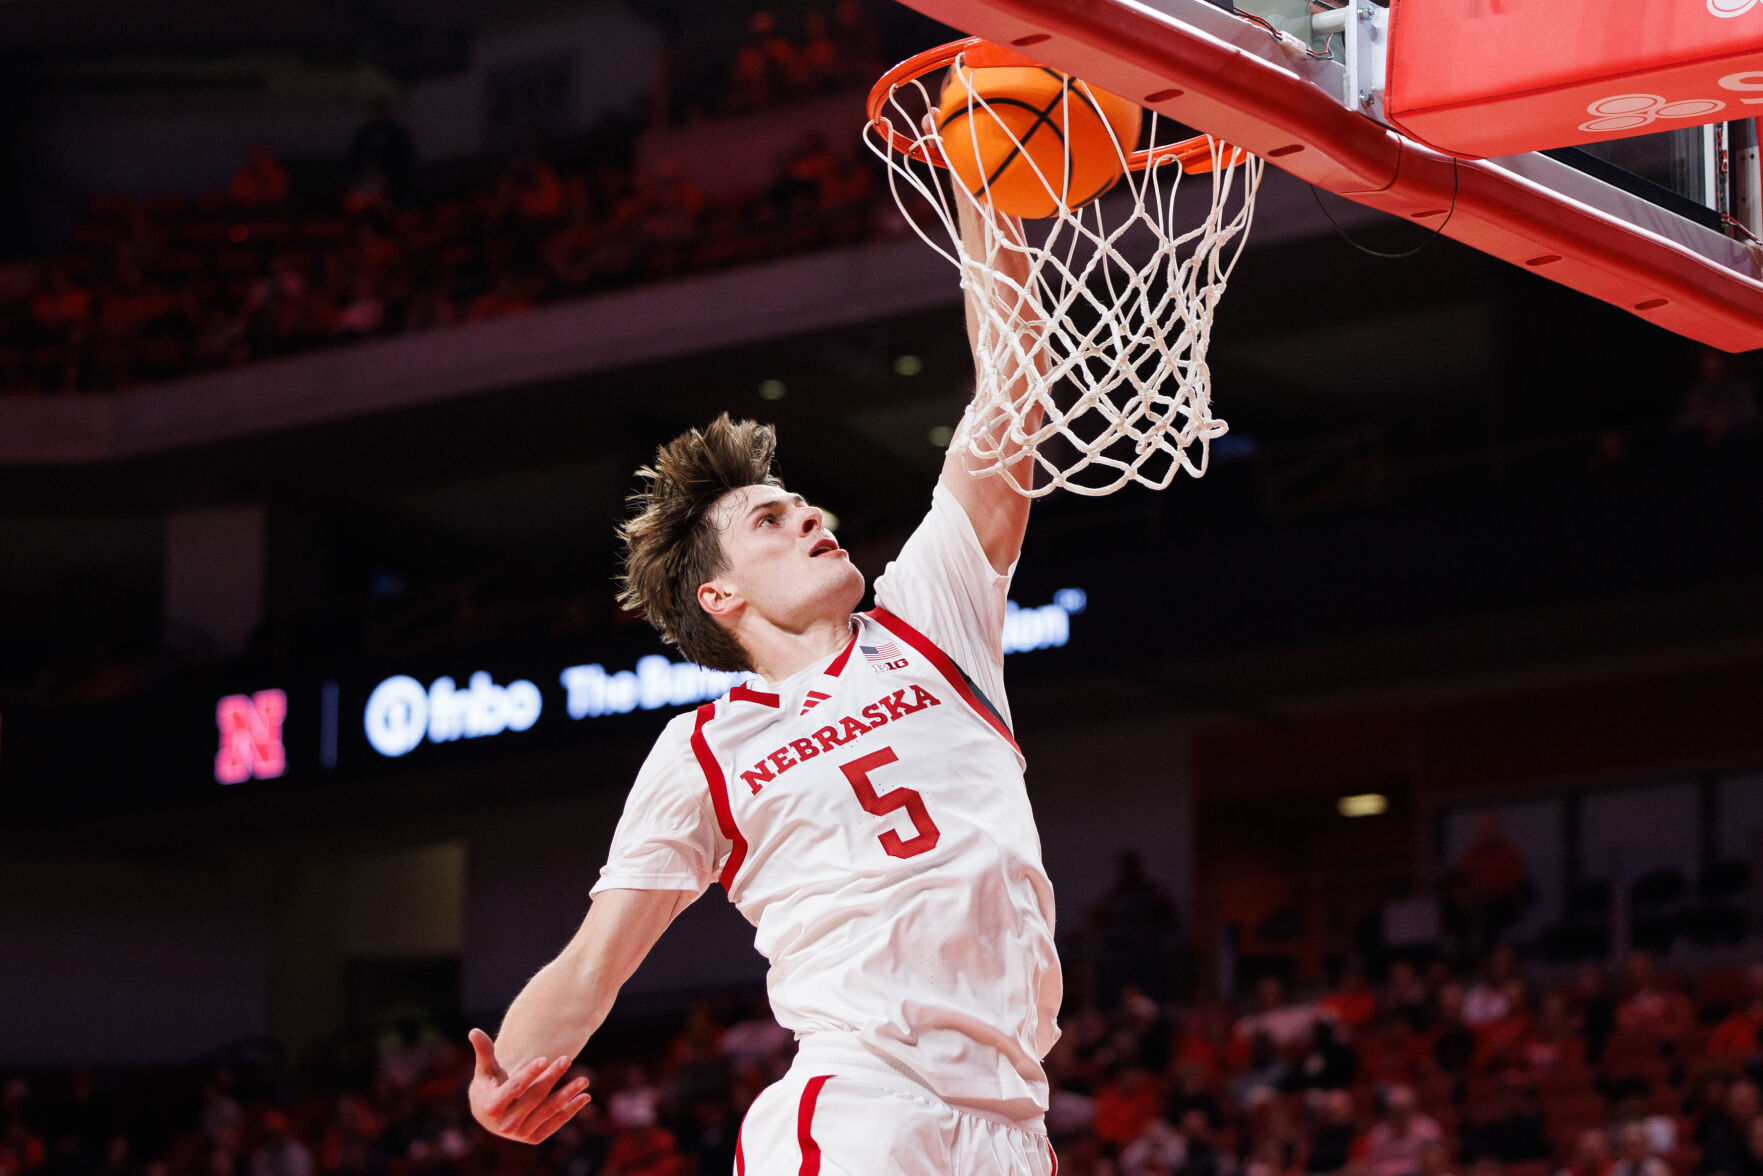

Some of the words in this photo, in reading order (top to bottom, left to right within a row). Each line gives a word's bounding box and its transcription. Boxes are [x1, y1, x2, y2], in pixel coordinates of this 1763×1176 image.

[215, 688, 287, 785] N
[559, 663, 637, 720] The
[740, 684, 941, 796] NEBRASKA
[839, 746, 940, 859] 5
